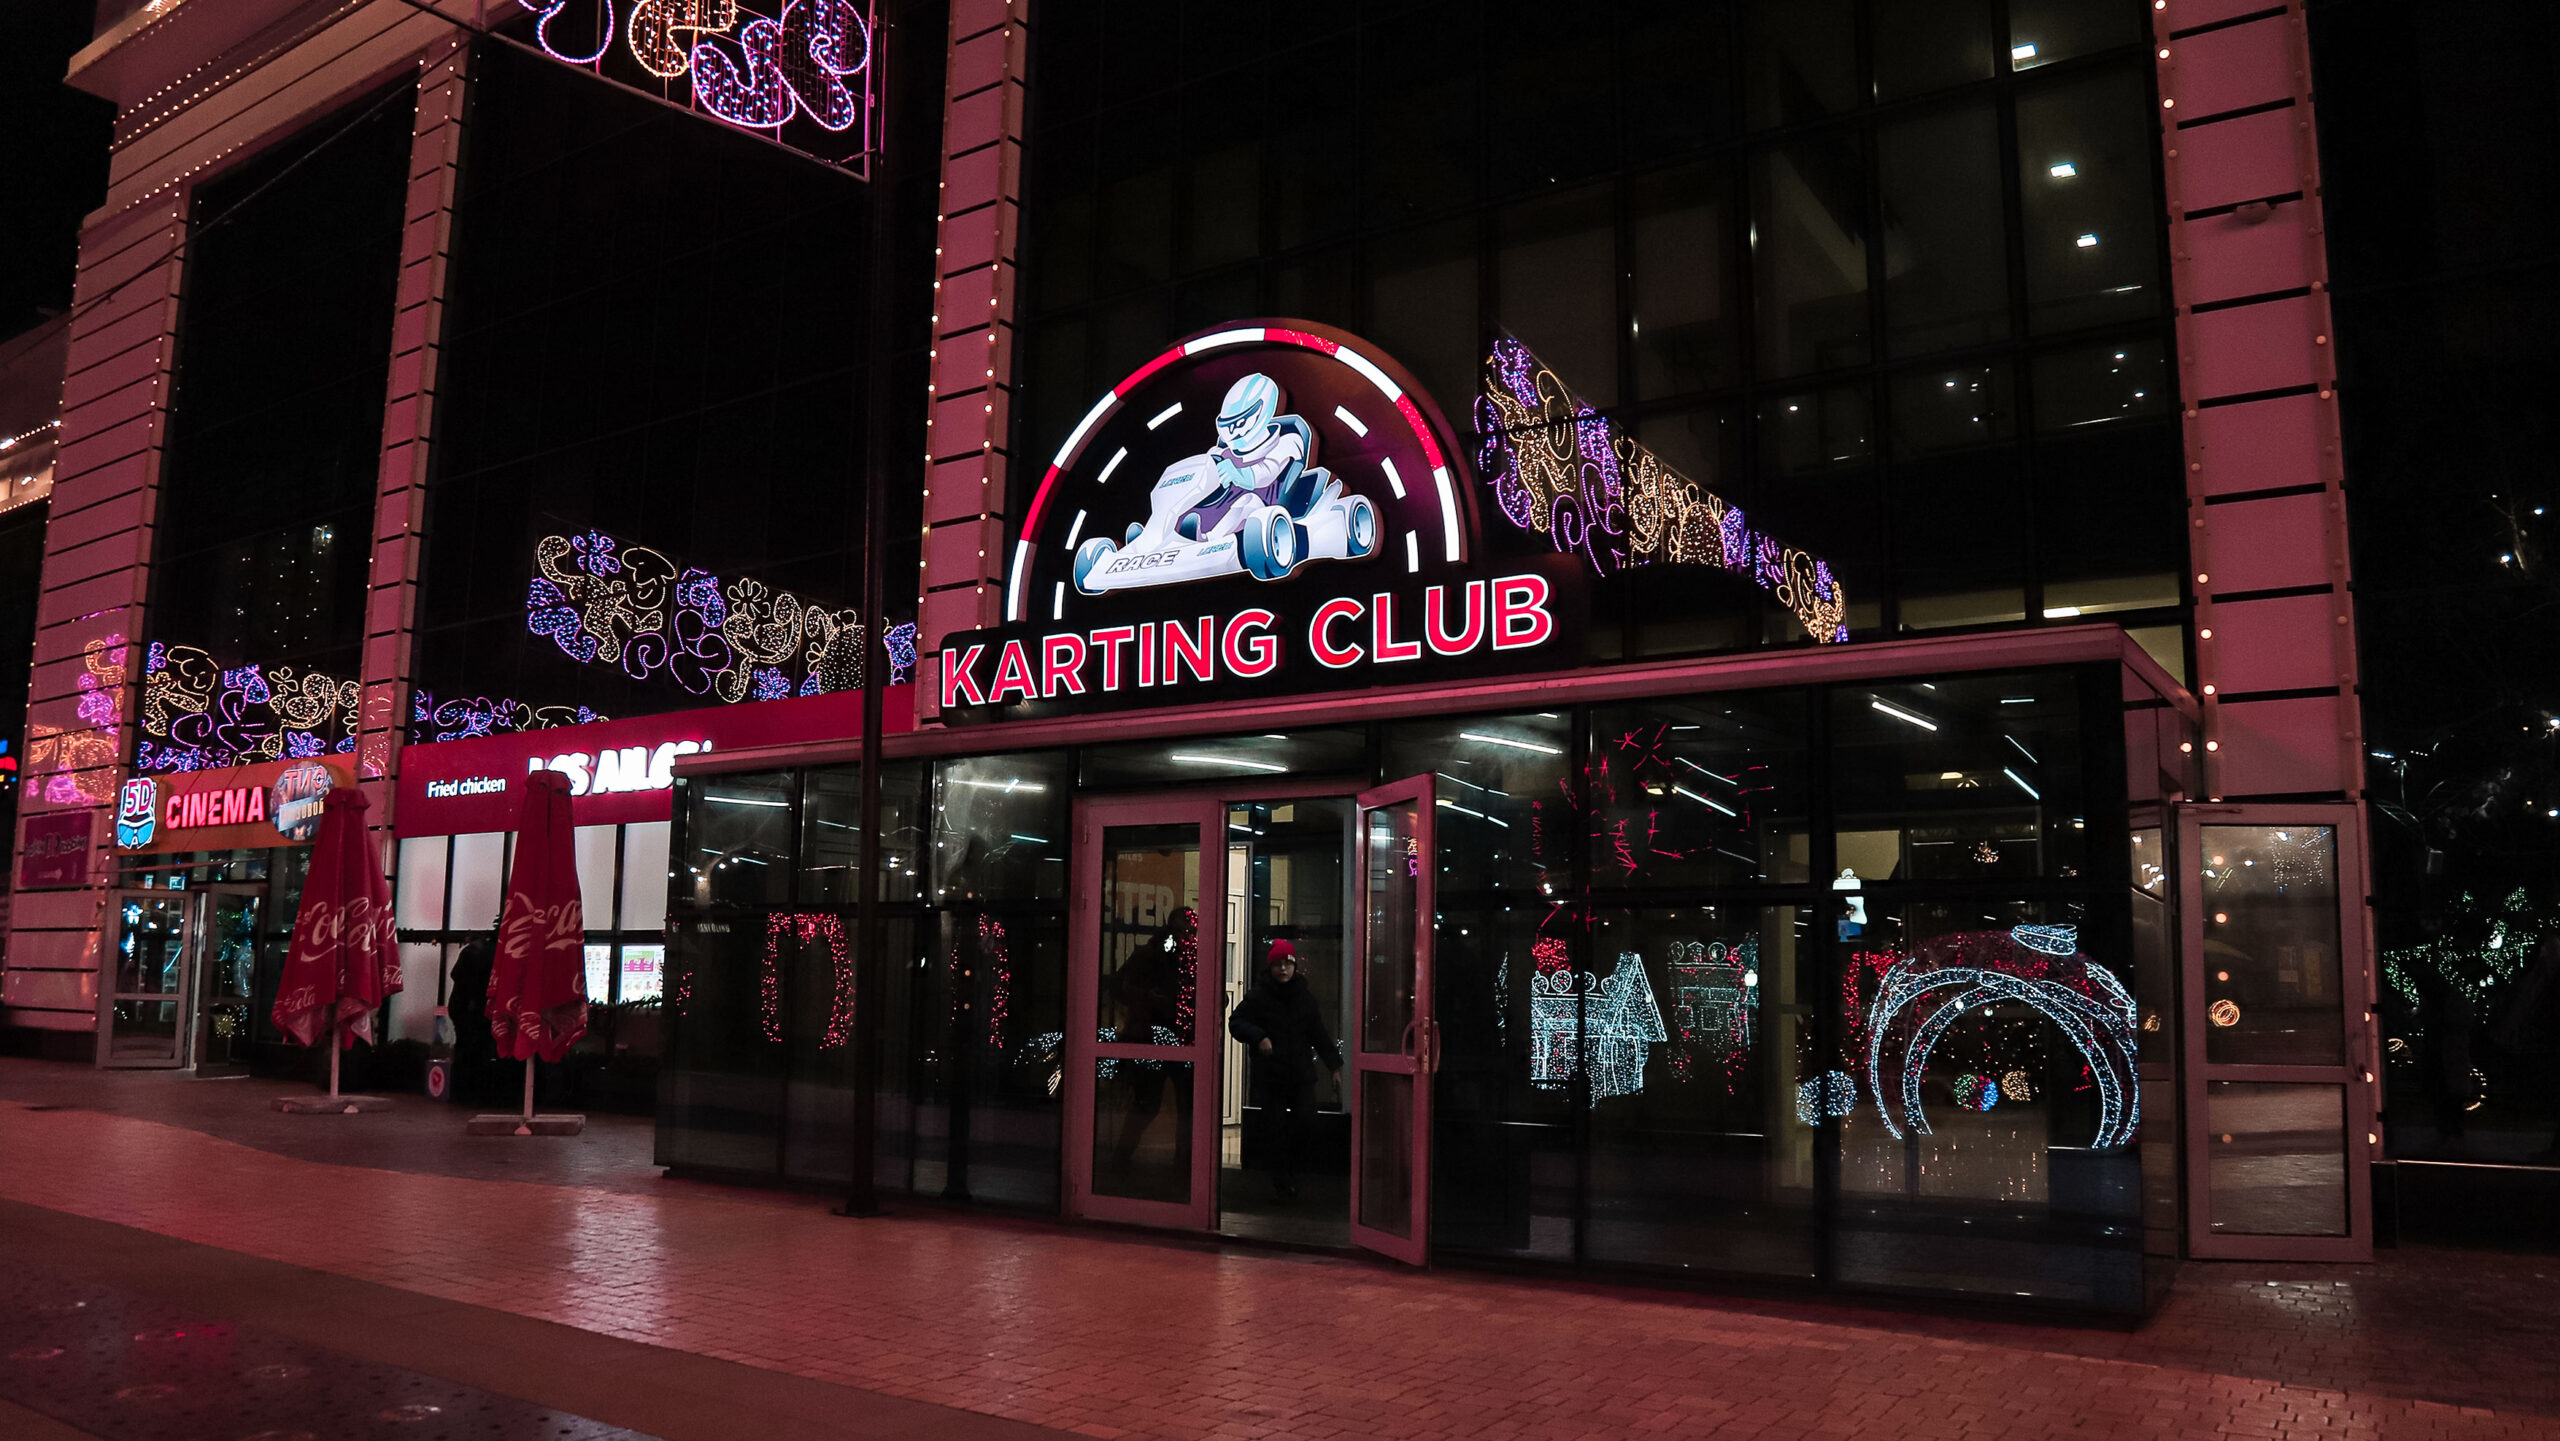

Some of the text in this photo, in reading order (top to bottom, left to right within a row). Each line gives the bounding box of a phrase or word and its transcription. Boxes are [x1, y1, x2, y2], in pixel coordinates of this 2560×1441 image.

[1105, 549, 1180, 574] RACE
[942, 574, 1552, 707] KARTING CLUB
[125, 777, 265, 829] 5D CINEMA
[427, 776, 506, 798] Fried chicken
